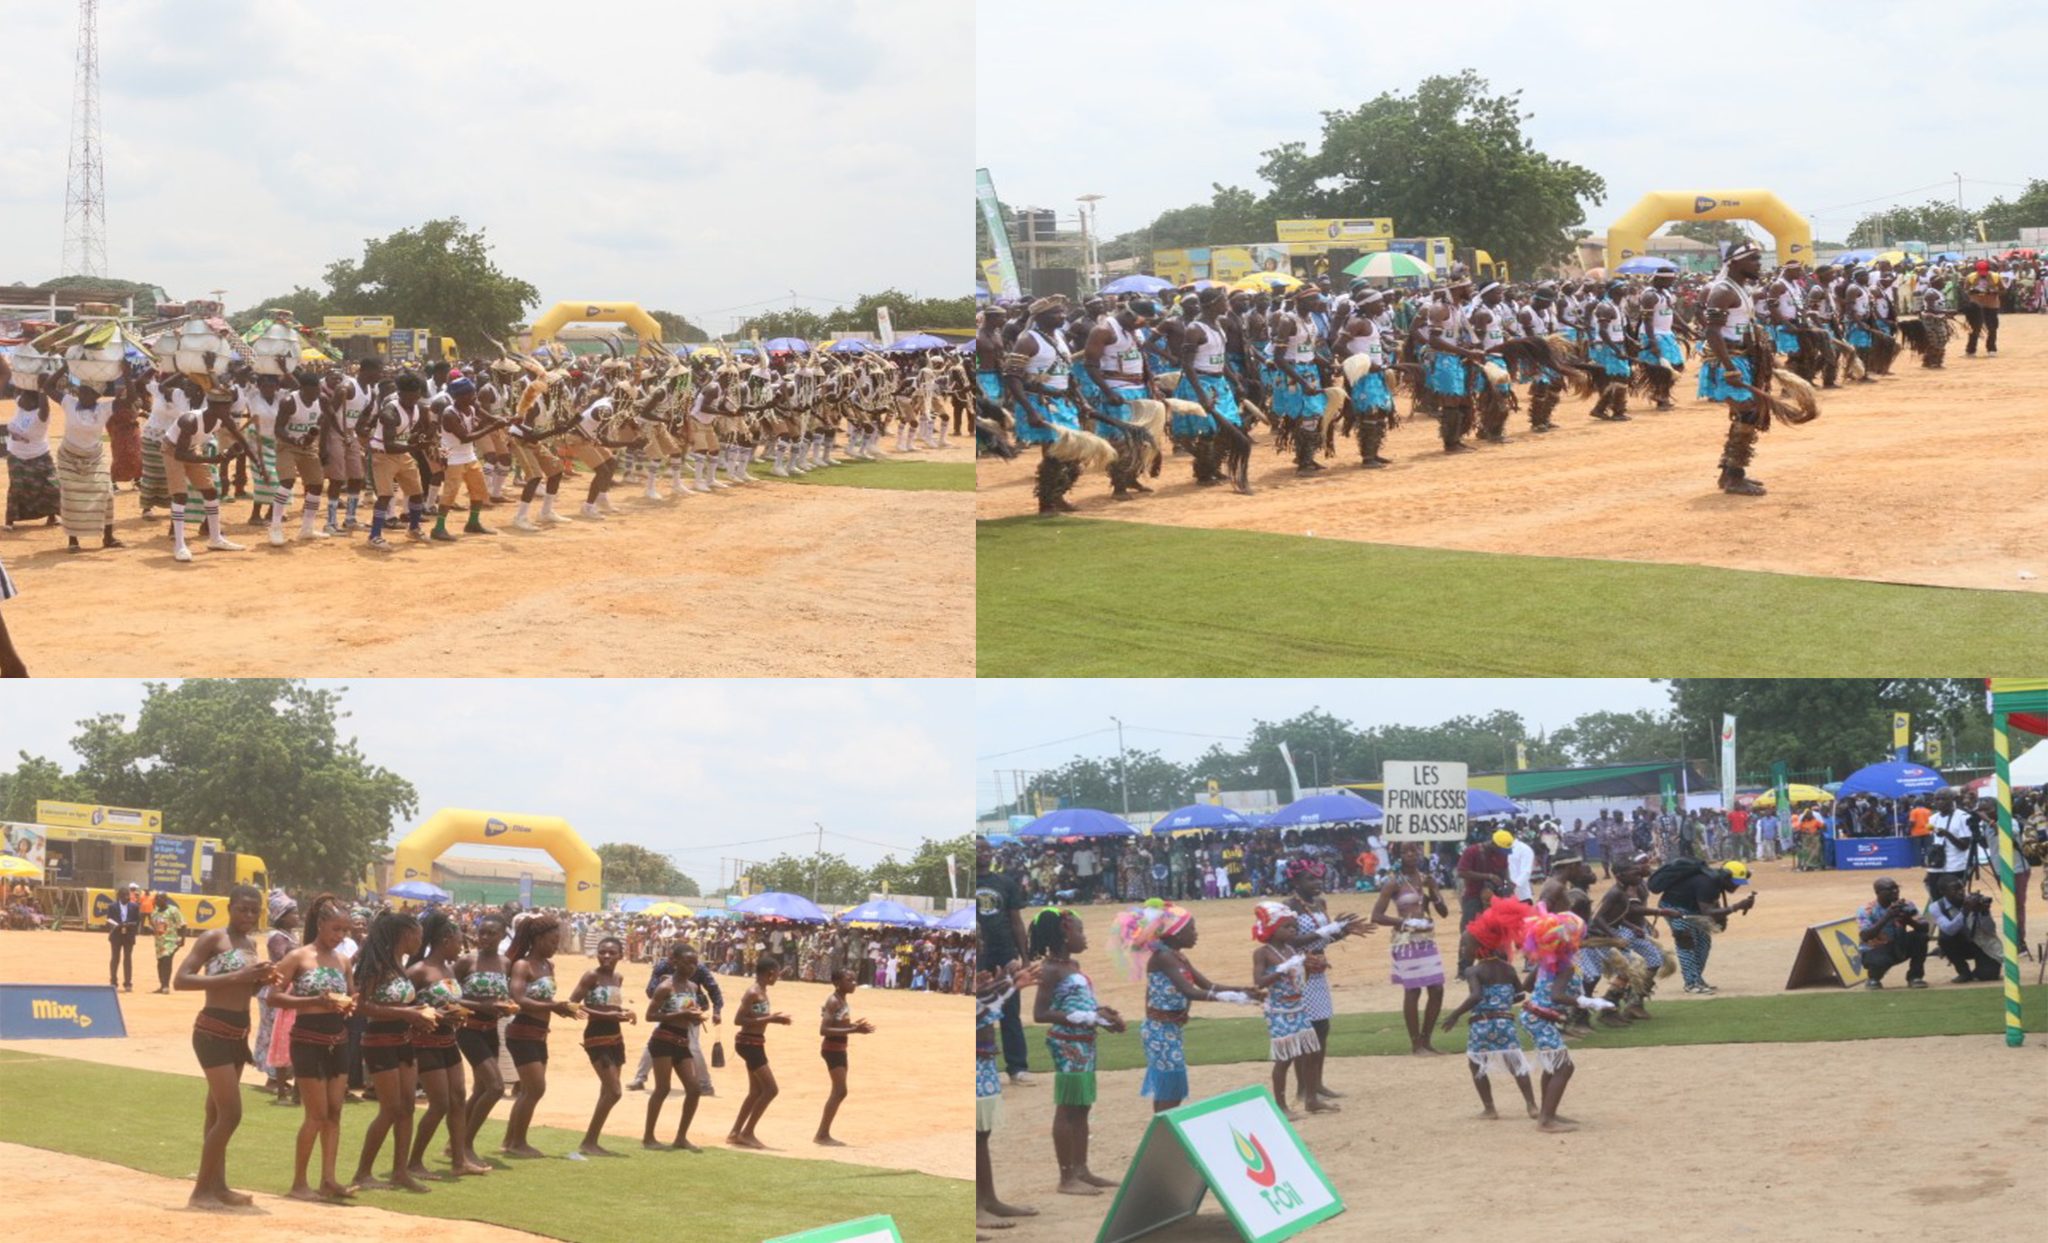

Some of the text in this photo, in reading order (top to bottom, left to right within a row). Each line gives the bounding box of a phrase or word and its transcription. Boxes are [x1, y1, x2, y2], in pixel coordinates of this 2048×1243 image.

[1413, 765, 1439, 785] LES
[1388, 789, 1466, 809] PRINCESSES
[1386, 814, 1465, 834] DE BASSAR
[32, 999, 78, 1019] Mixx
